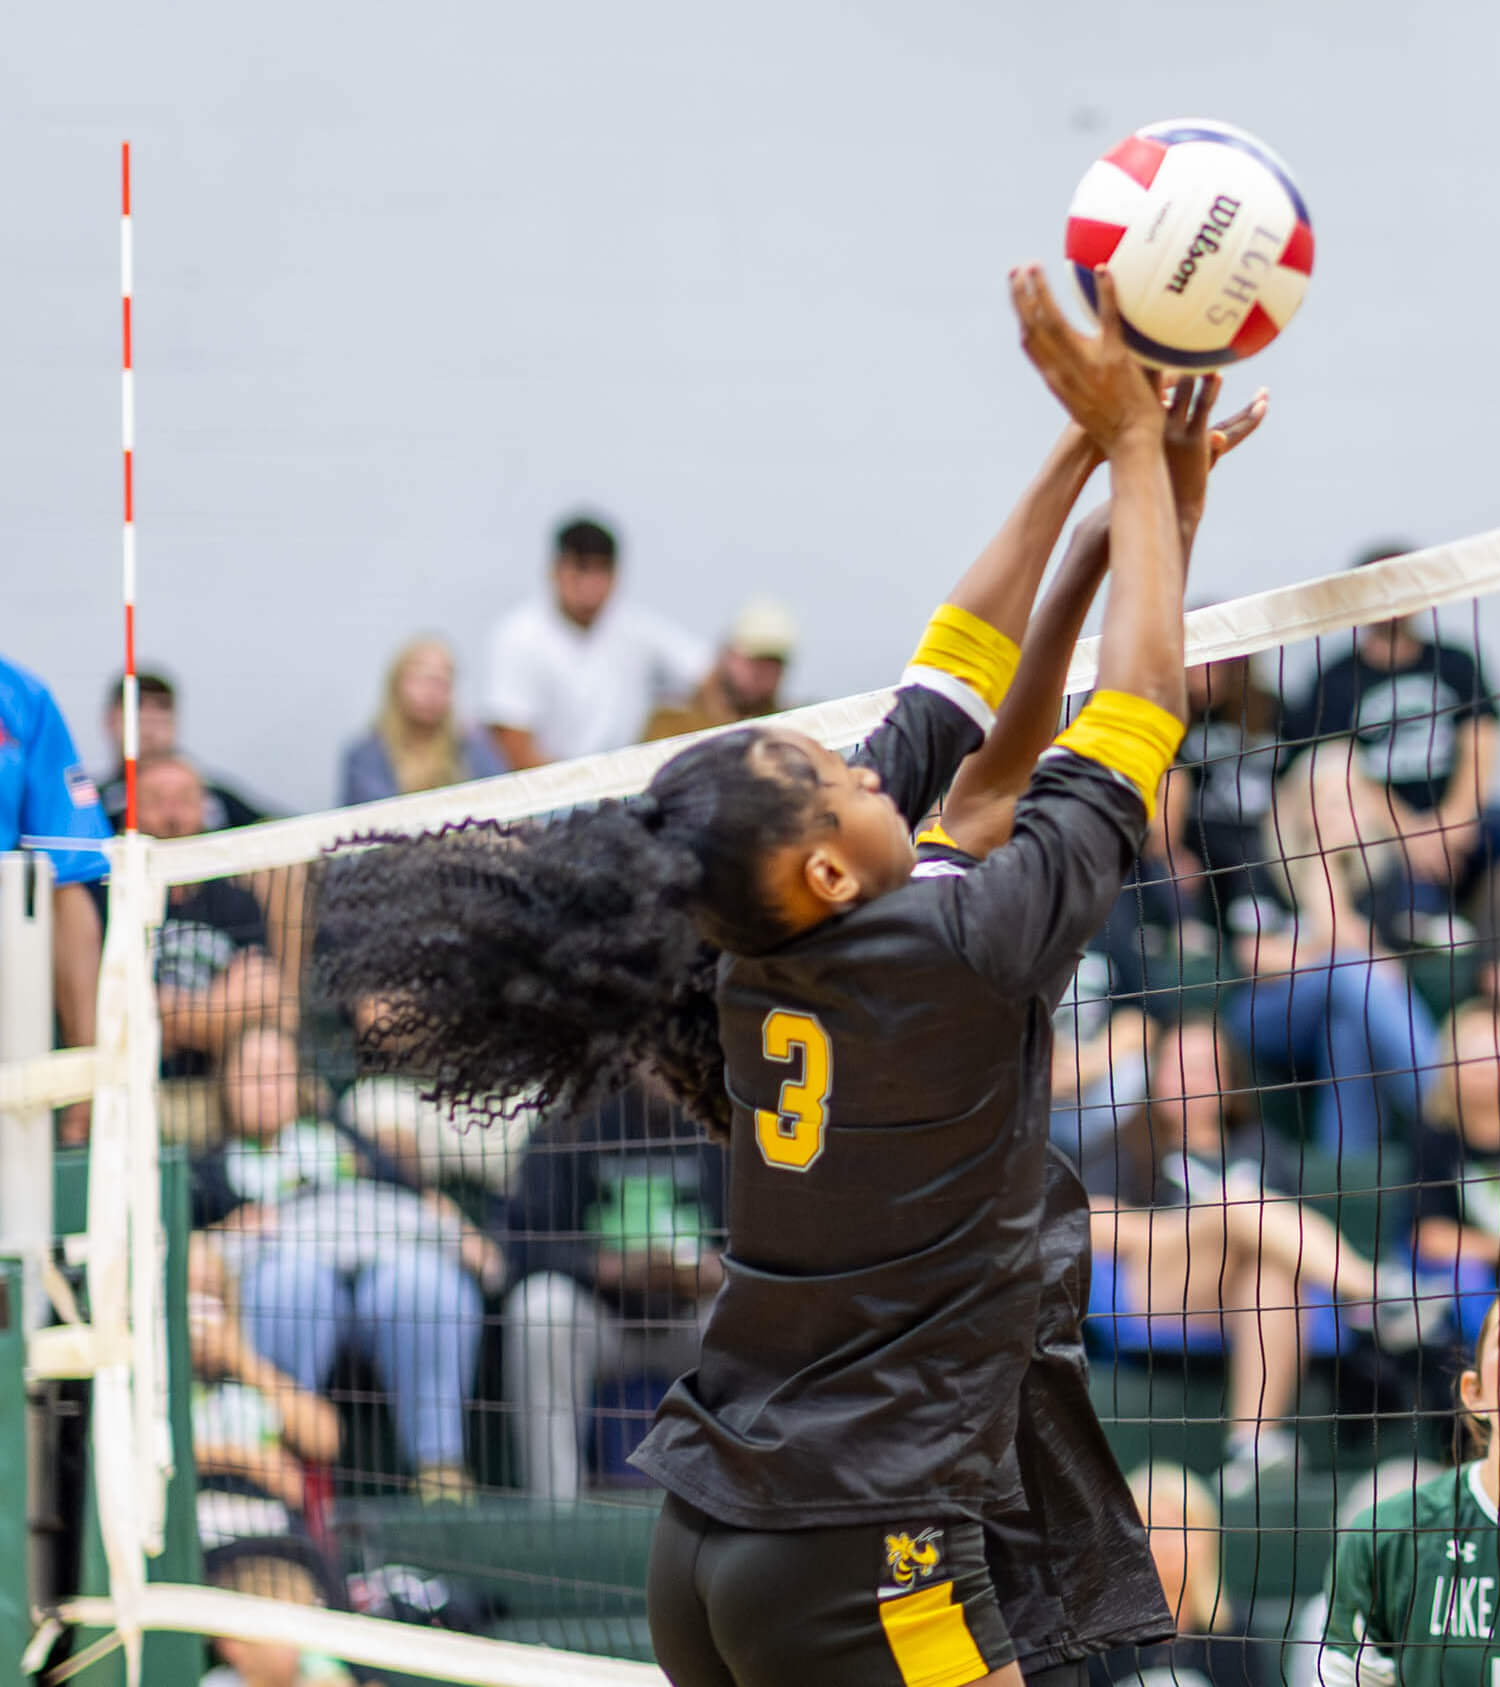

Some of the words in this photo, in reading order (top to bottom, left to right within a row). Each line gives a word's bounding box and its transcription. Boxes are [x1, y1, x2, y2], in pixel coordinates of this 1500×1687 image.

[1165, 194, 1241, 294] Wilson
[1206, 226, 1281, 326] LCHS
[755, 1008, 834, 1173] 3
[1429, 1576, 1495, 1638] LAKE
